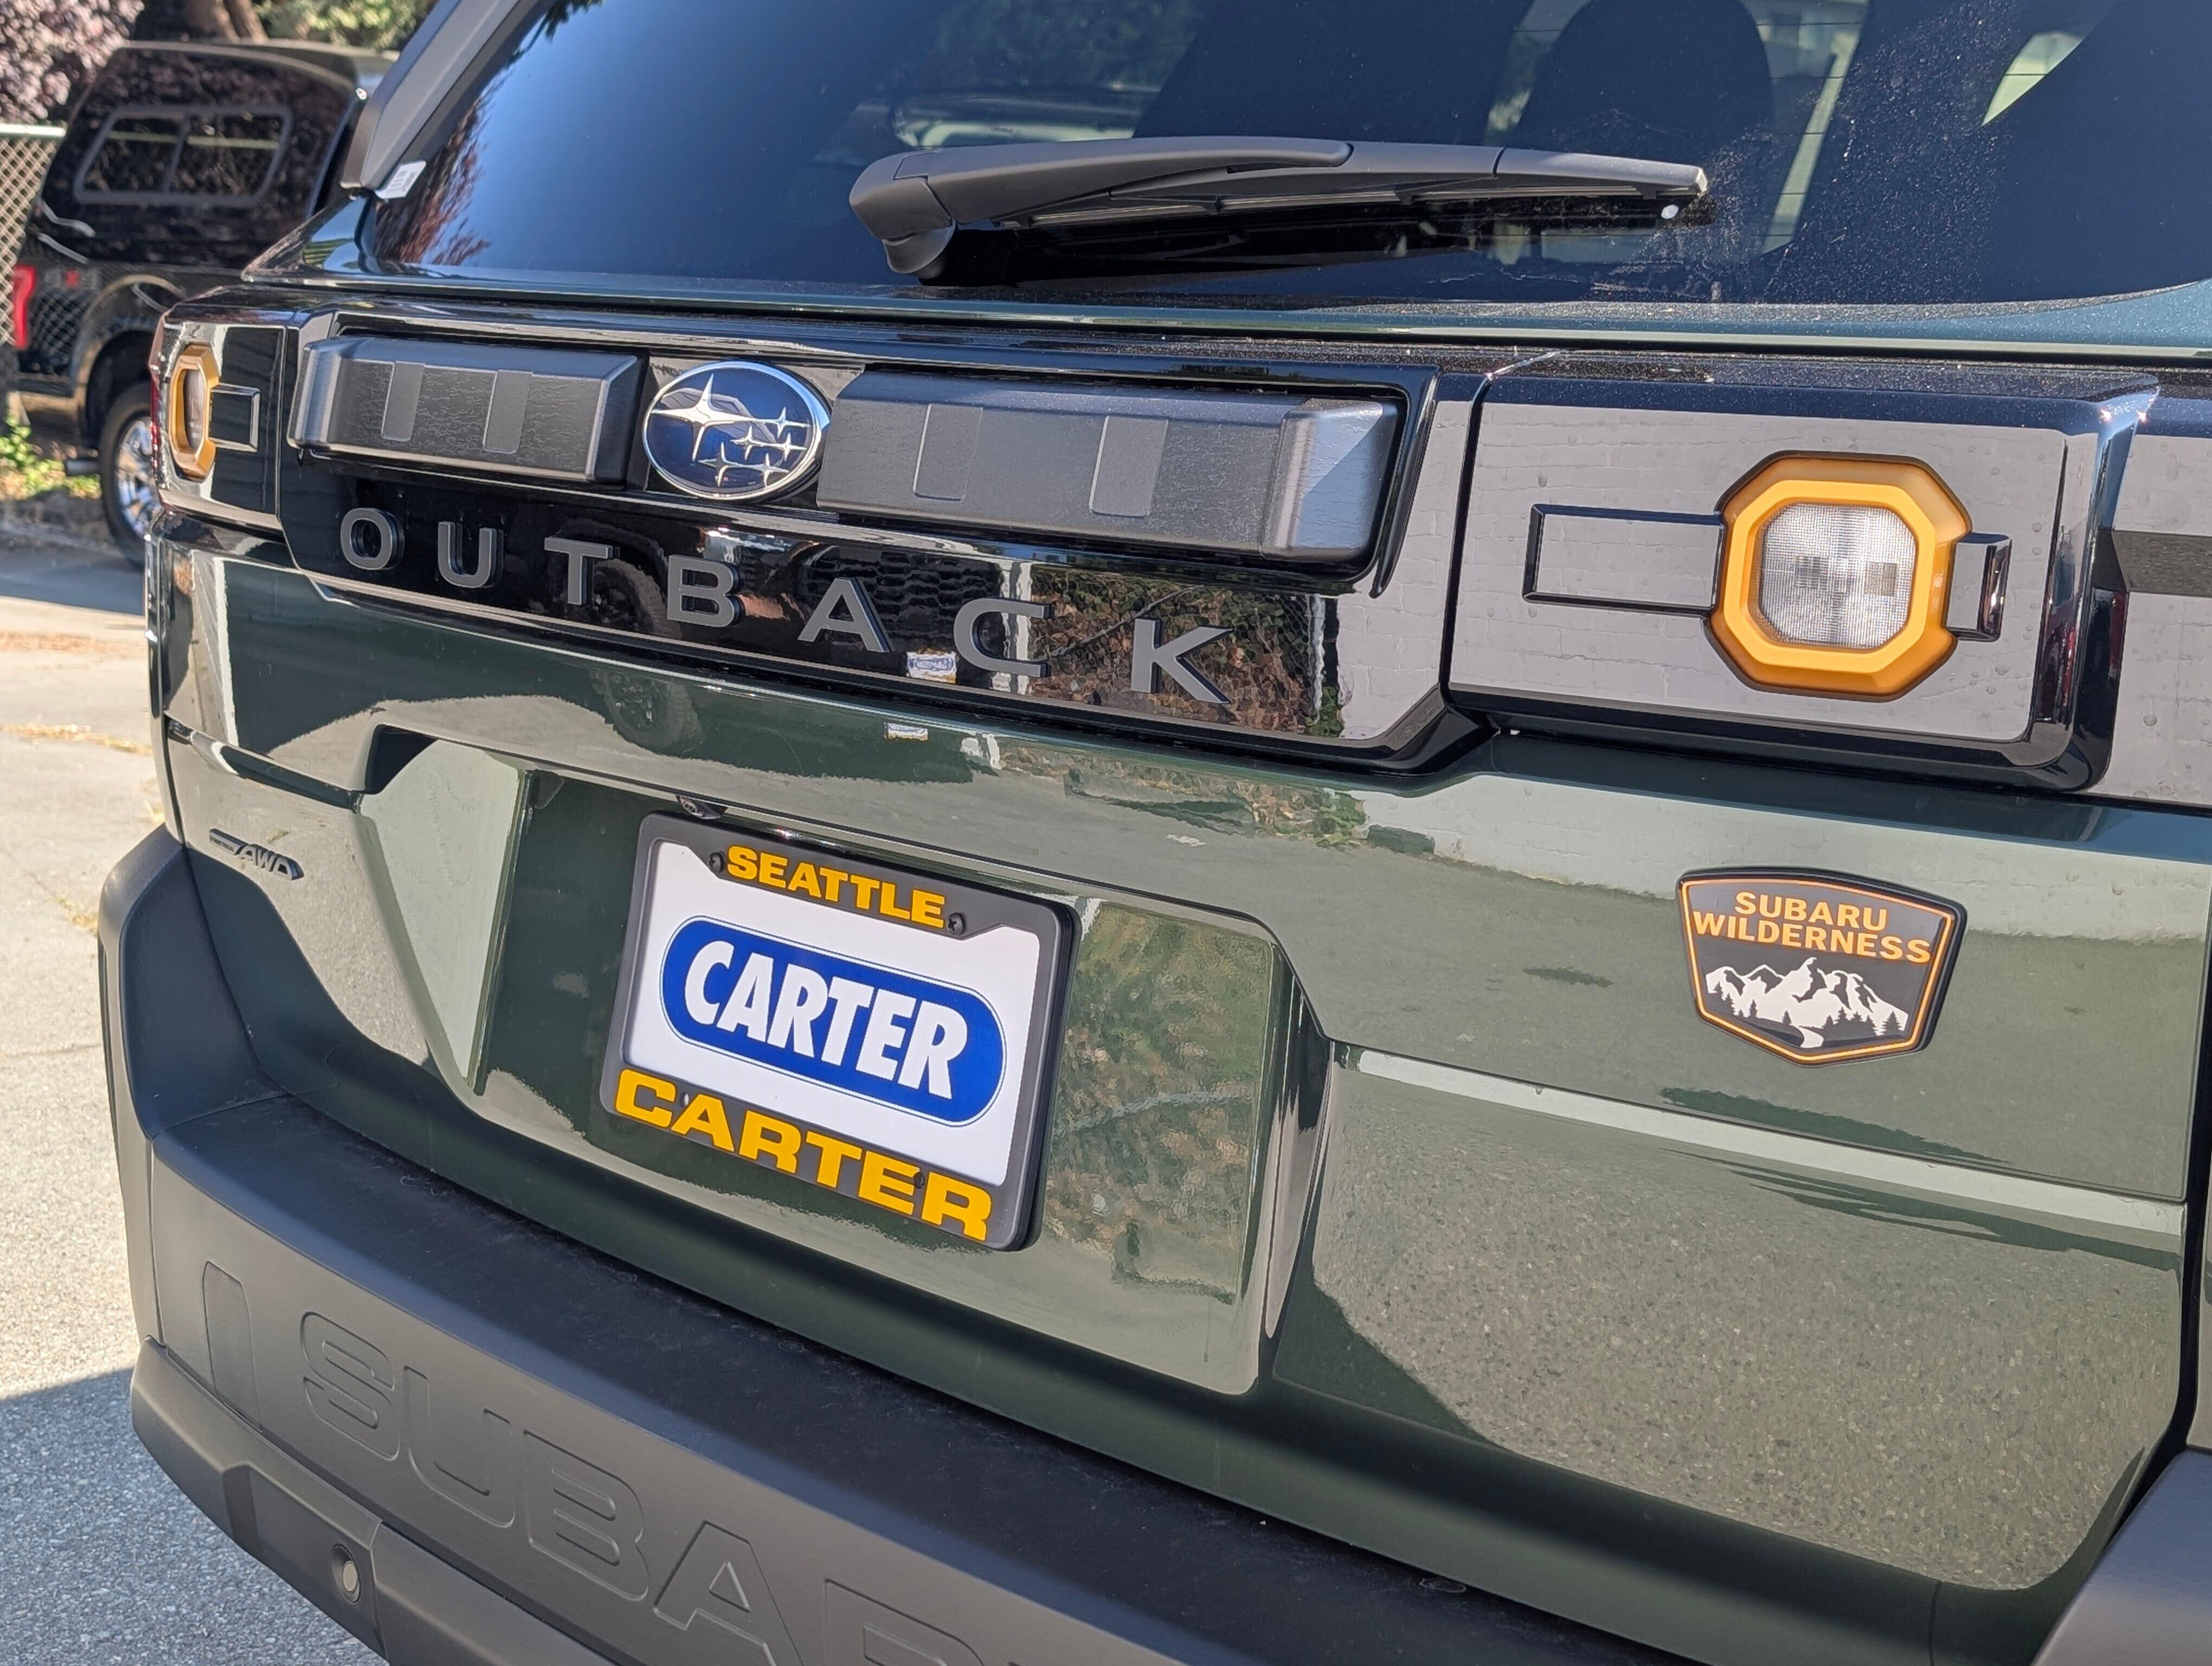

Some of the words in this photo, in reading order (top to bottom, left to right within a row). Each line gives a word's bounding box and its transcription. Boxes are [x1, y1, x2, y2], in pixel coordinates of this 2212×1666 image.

[340, 508, 1234, 704] OUTBACK
[237, 844, 299, 880] AWD
[726, 845, 946, 928] SEATTLE
[1735, 892, 1887, 931] SUBARU
[1693, 911, 1931, 963] WILDERNESS
[684, 940, 968, 1100] CARTER
[615, 1069, 992, 1241] CARTER
[300, 1311, 1020, 1666] SUBA
